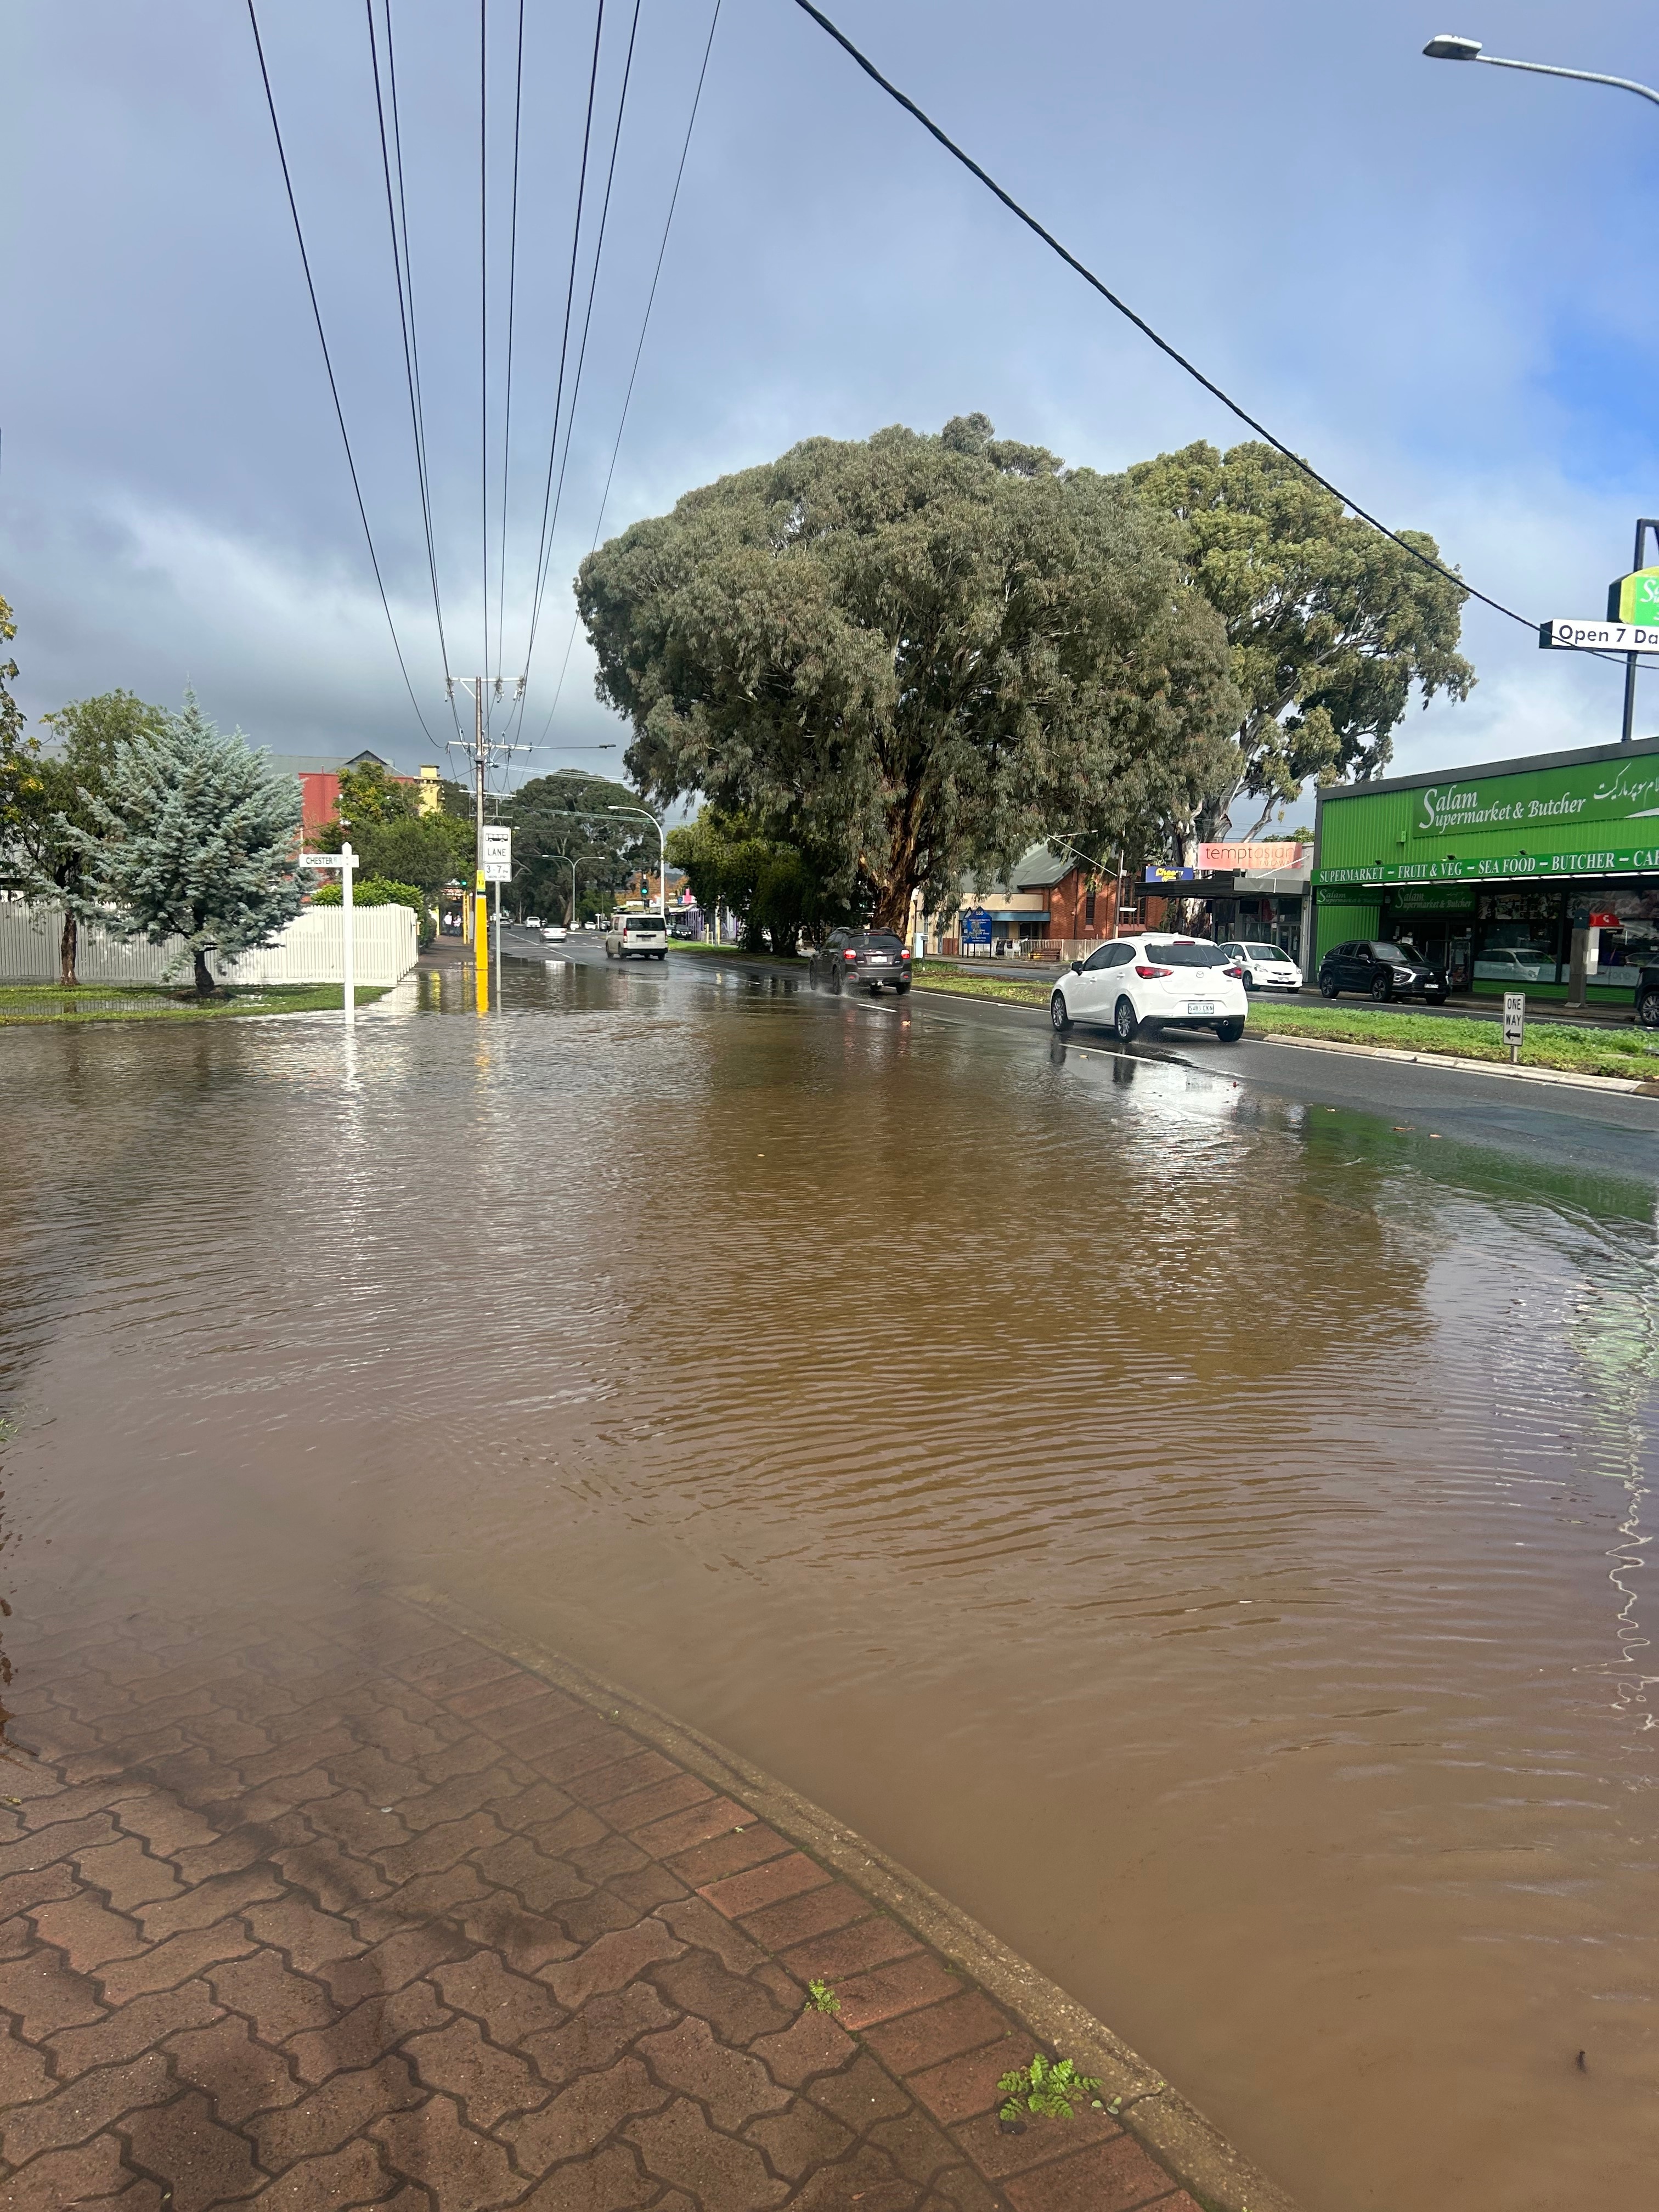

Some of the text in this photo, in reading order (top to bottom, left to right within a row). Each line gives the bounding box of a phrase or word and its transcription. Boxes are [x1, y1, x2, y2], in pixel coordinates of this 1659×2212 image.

[1559, 624, 1609, 645] Open
[1616, 628, 1627, 642] 7
[1419, 785, 1478, 828] Salam
[1513, 802, 1525, 819] &
[1528, 792, 1587, 818] Butcher
[487, 848, 506, 856] LANE
[487, 865, 491, 873] 3
[496, 865, 502, 873] 7
[1319, 867, 1385, 883] SUPERMARKET
[1398, 865, 1428, 878] FRUIT
[1429, 863, 1437, 877] &
[1441, 862, 1463, 876] VEG
[1479, 860, 1499, 874] SEA
[1502, 857, 1536, 873] FOOD
[1551, 852, 1615, 871] BUTCHER
[1395, 887, 1425, 908] Salam
[1507, 998, 1521, 1010] ONE
[1506, 1013, 1522, 1026] WAY
